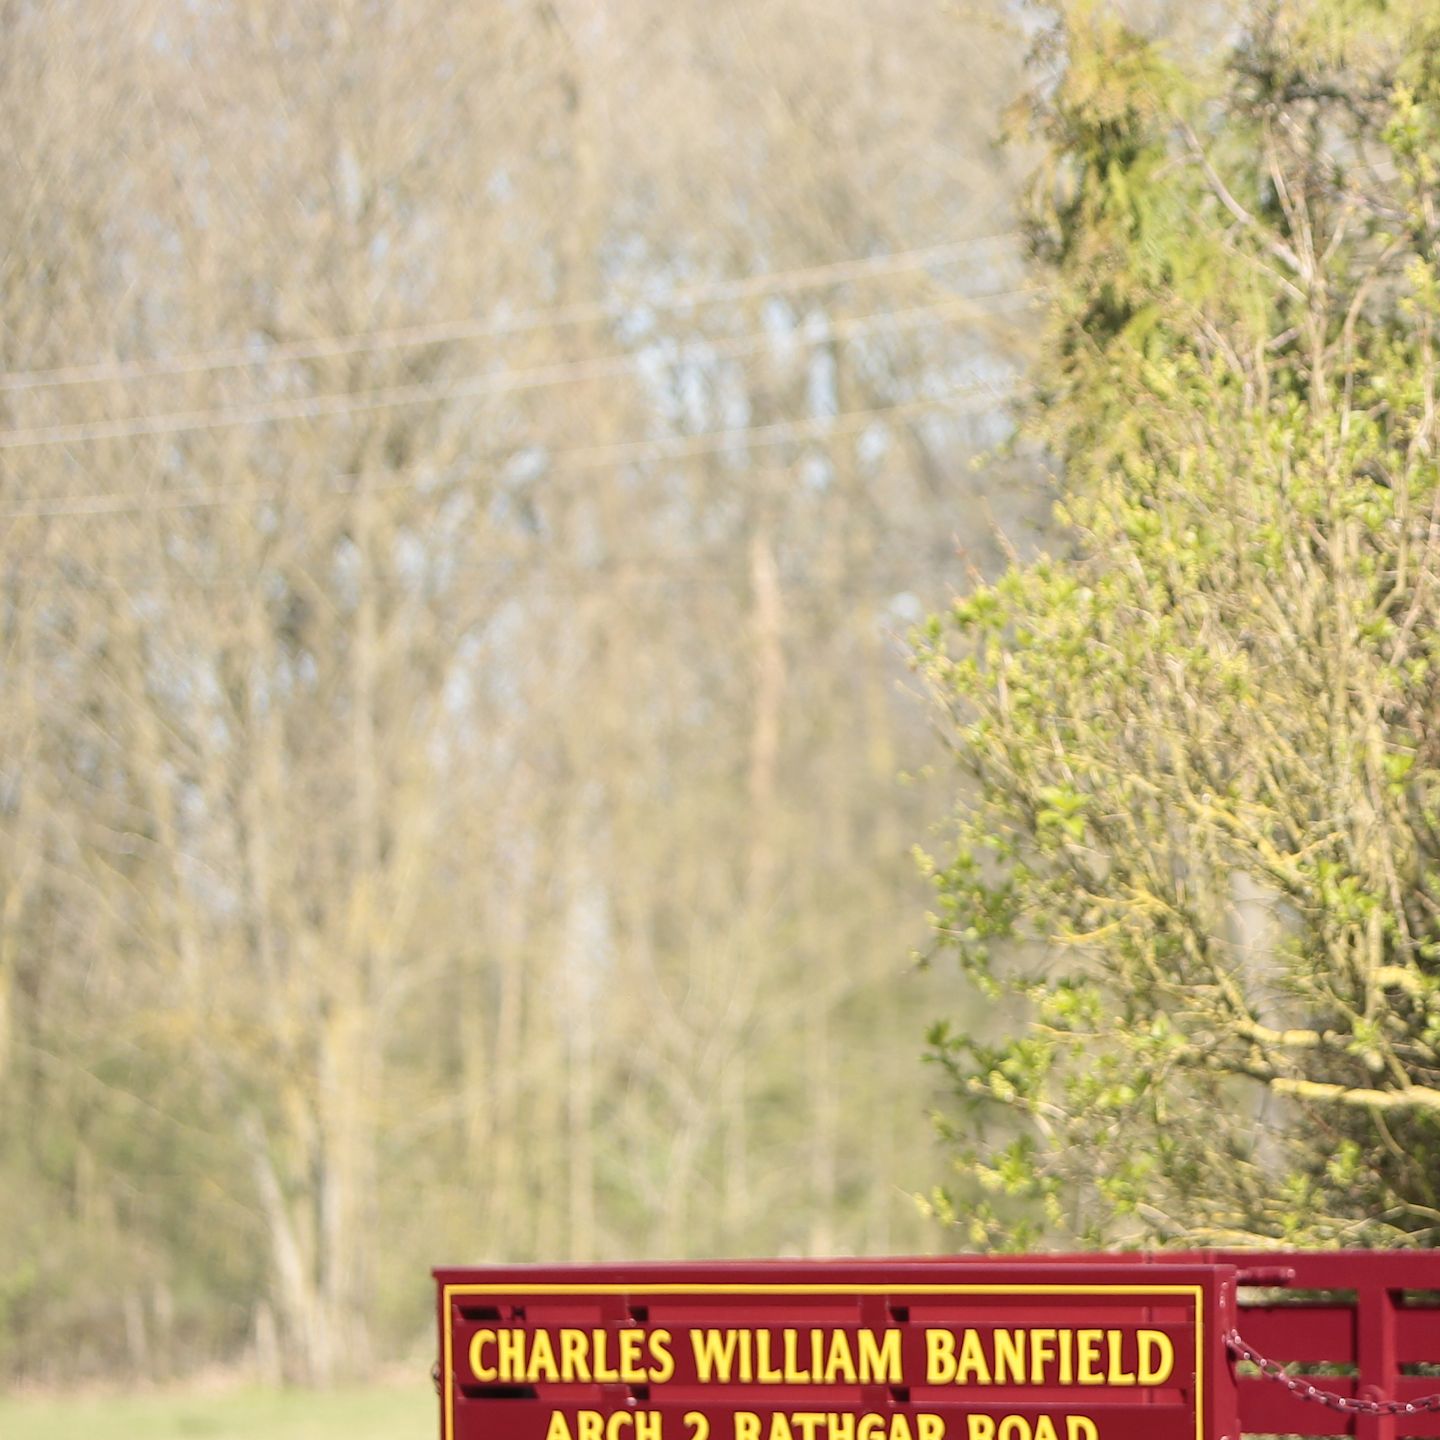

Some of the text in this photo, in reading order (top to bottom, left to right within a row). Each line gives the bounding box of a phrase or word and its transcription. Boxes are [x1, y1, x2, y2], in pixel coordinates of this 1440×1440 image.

[469, 1328, 1174, 1387] CHARLES WILLIAM BANFIELD
